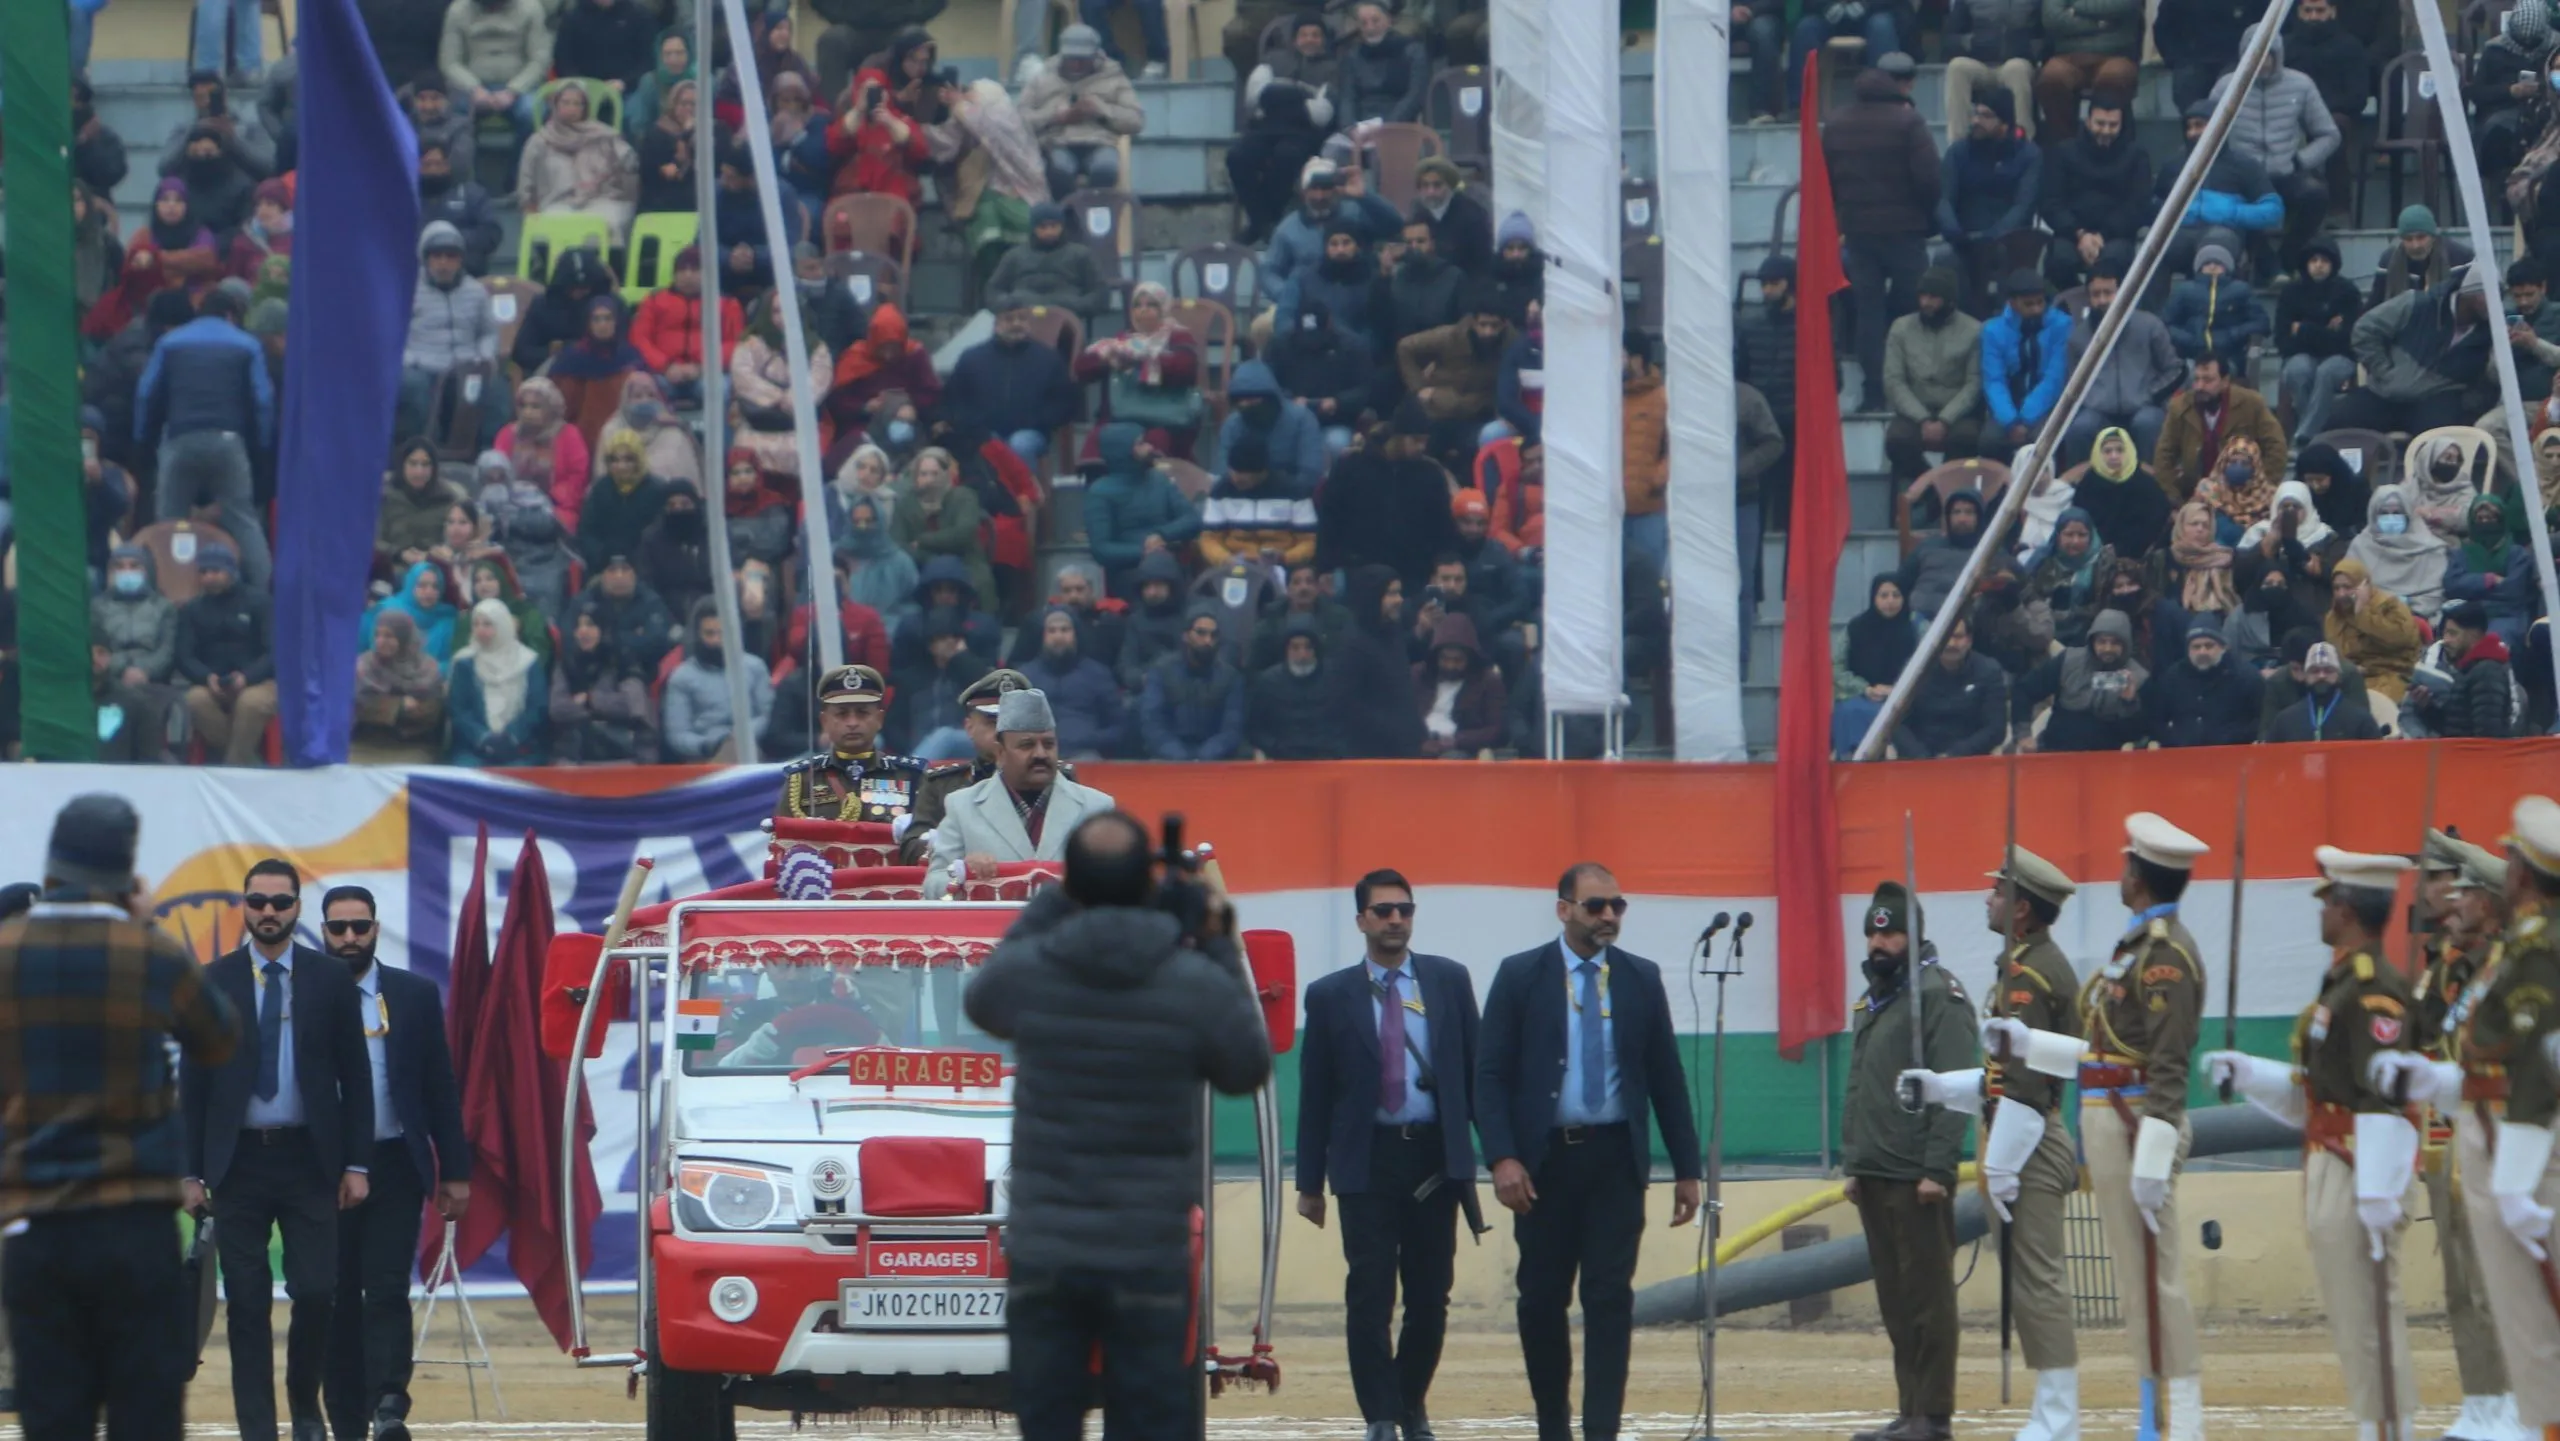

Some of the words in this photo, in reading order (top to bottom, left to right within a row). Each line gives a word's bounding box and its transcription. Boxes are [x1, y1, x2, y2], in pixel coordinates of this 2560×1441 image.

[854, 1053, 997, 1084] GARAGES
[878, 1251, 979, 1268] GARAGES
[862, 1291, 1006, 1317] JK02CH0227
